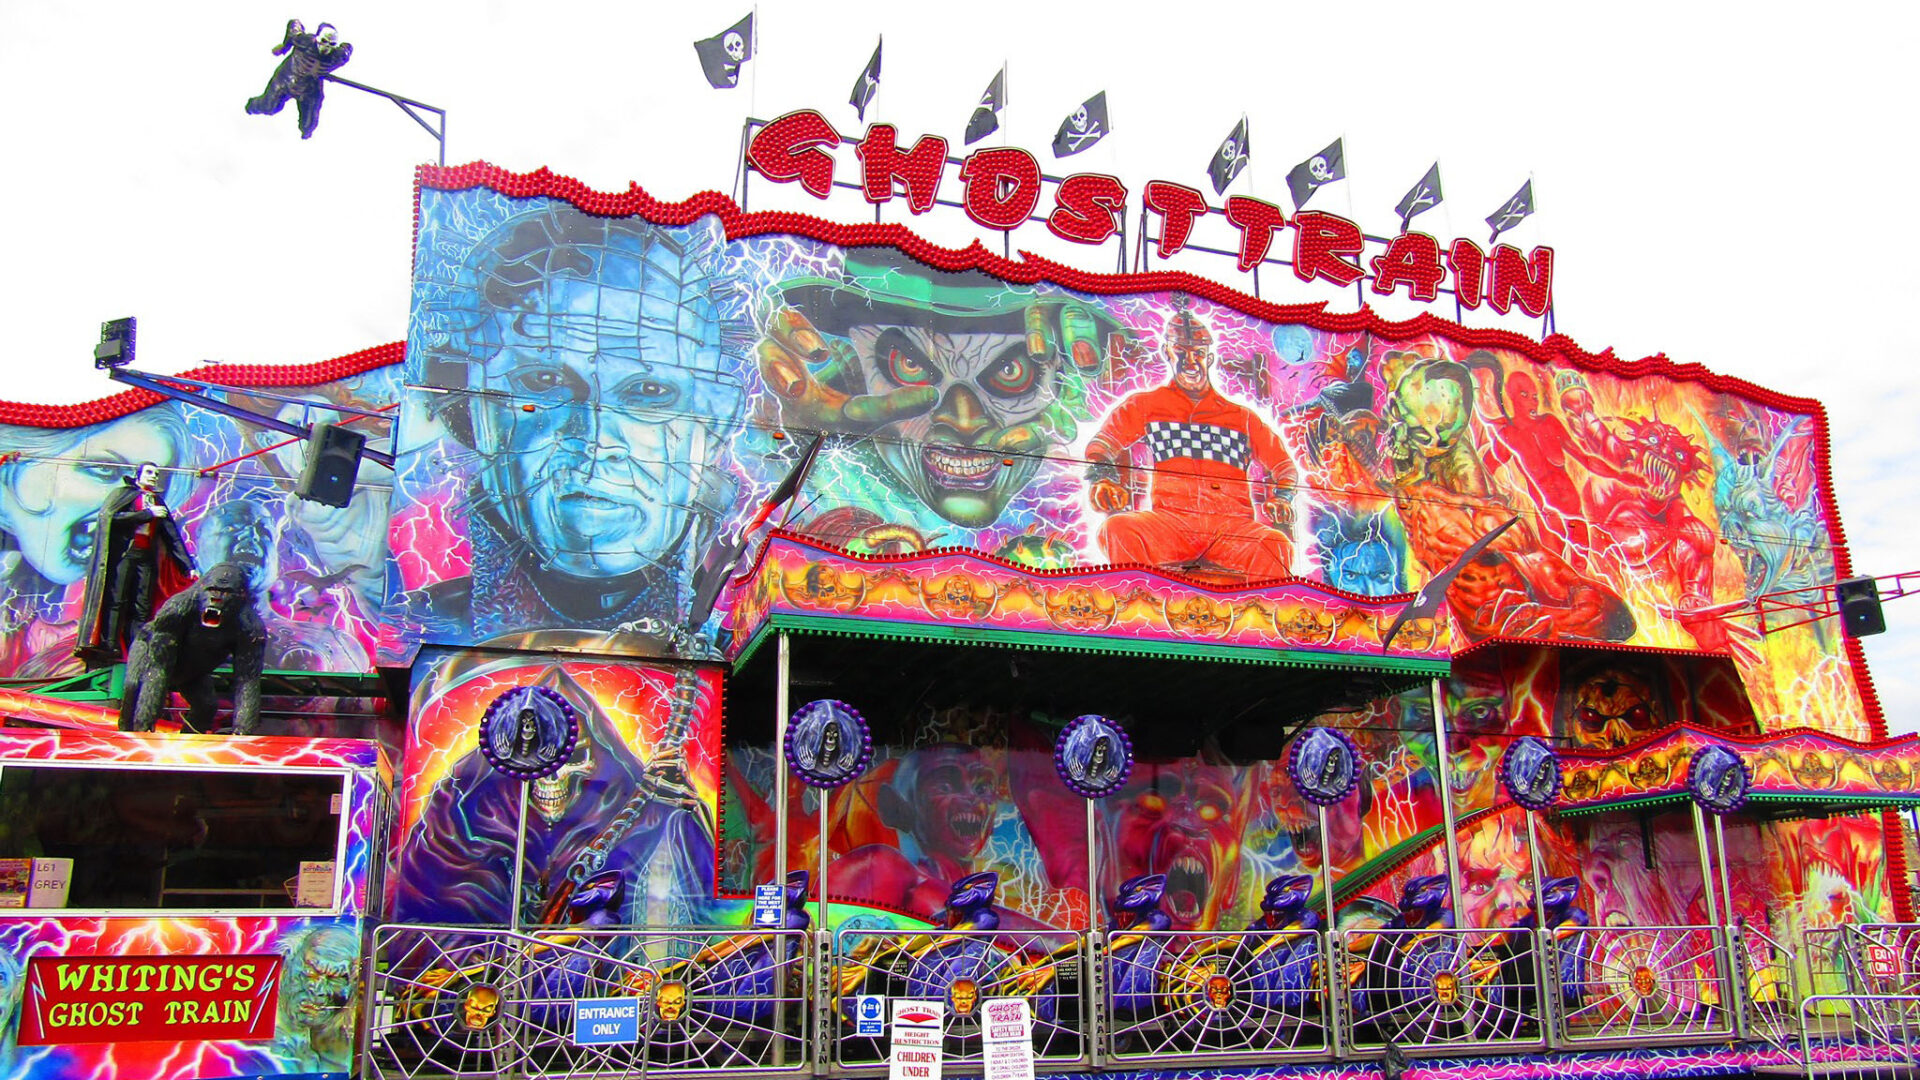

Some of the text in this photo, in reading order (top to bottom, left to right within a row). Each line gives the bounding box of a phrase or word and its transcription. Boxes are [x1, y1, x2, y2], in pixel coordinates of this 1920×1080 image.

[746, 109, 1554, 318] GHOST TRAIN
[34, 880, 67, 889] GREY
[57, 964, 256, 993] WHITING'S
[49, 1000, 252, 1027] GHOST TRAIN
[578, 1006, 636, 1020] ENTRANCE
[896, 1006, 919, 1017] GHOST
[988, 1003, 1023, 1013] GHOST
[990, 1013, 1022, 1022] TRAIN
[592, 1023, 621, 1035] ONLY
[897, 1051, 937, 1063] CHILDREN
[902, 1066, 930, 1078] UNDER
